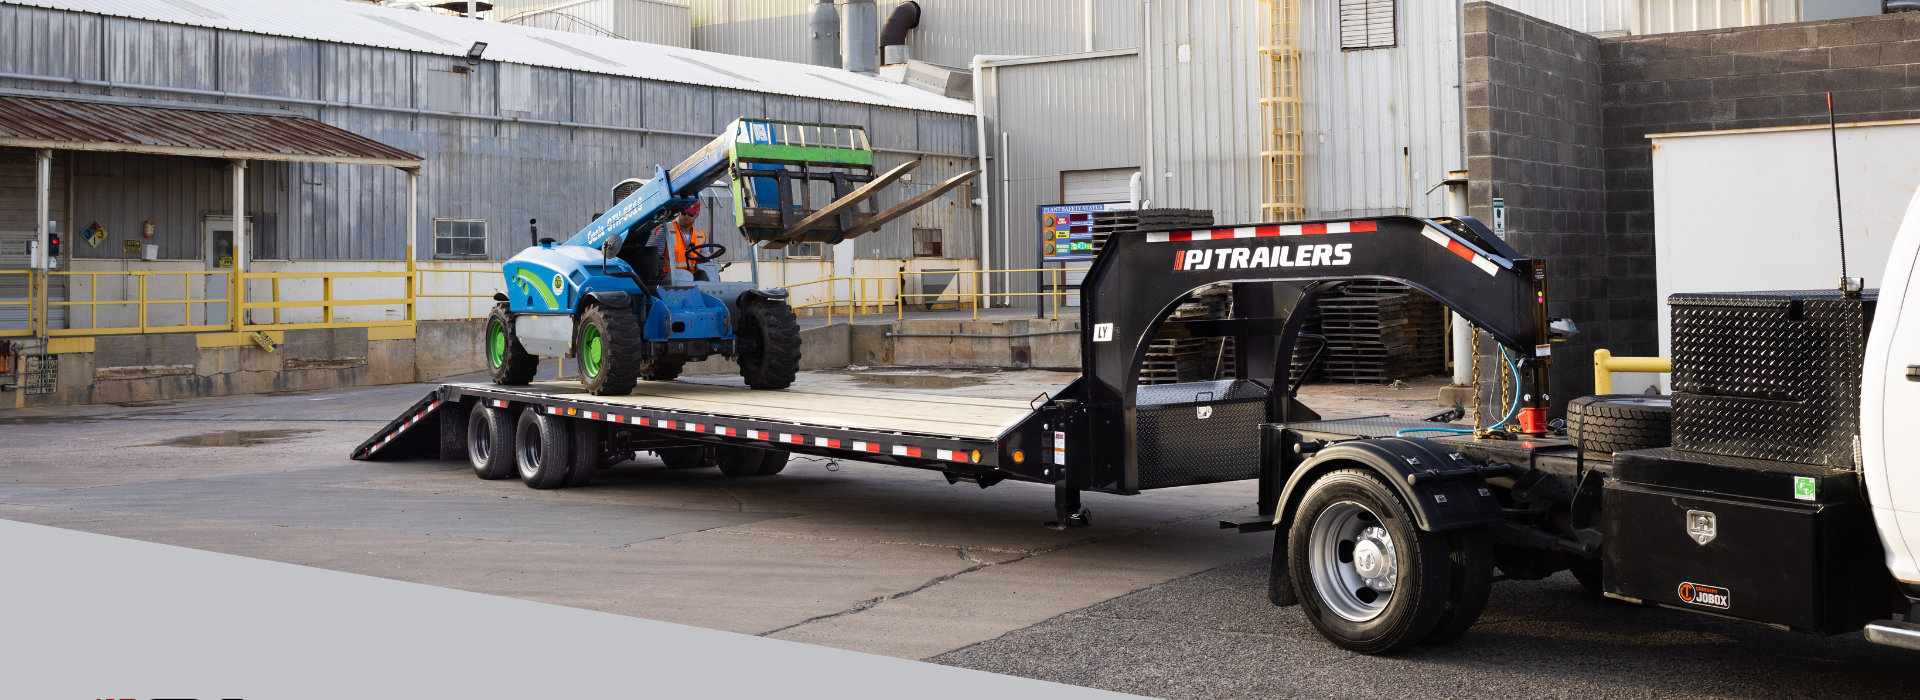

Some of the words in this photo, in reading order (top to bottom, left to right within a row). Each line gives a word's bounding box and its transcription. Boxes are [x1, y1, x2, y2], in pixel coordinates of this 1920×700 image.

[98, 229, 104, 239] 3
[1183, 249, 1213, 271] PJ
[1214, 243, 1353, 270] TRAILERS
[1098, 326, 1108, 338] LY
[1696, 592, 1727, 606] JOBOX
